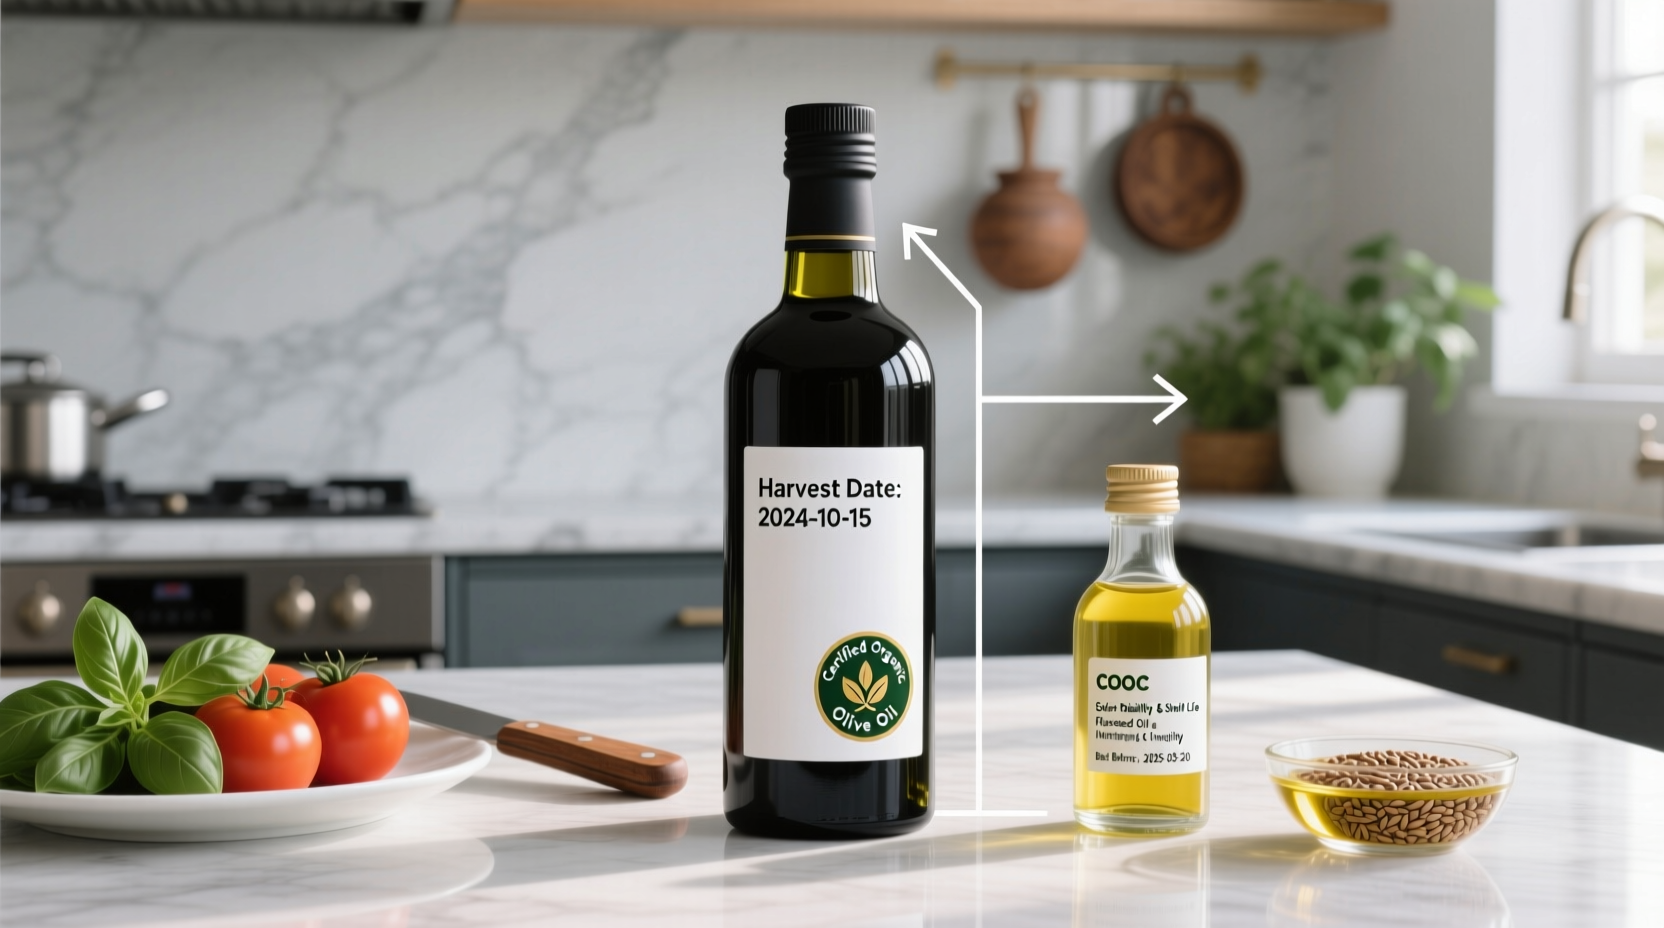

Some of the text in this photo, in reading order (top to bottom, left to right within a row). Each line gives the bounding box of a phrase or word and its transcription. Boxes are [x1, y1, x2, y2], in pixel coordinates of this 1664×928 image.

[758, 477, 901, 498] Harvest Date:
[758, 506, 872, 528] 2024-10-15
[1096, 673, 1150, 691] COOC
[832, 704, 899, 732] Olive Oil
[1136, 718, 1149, 729] Oil
